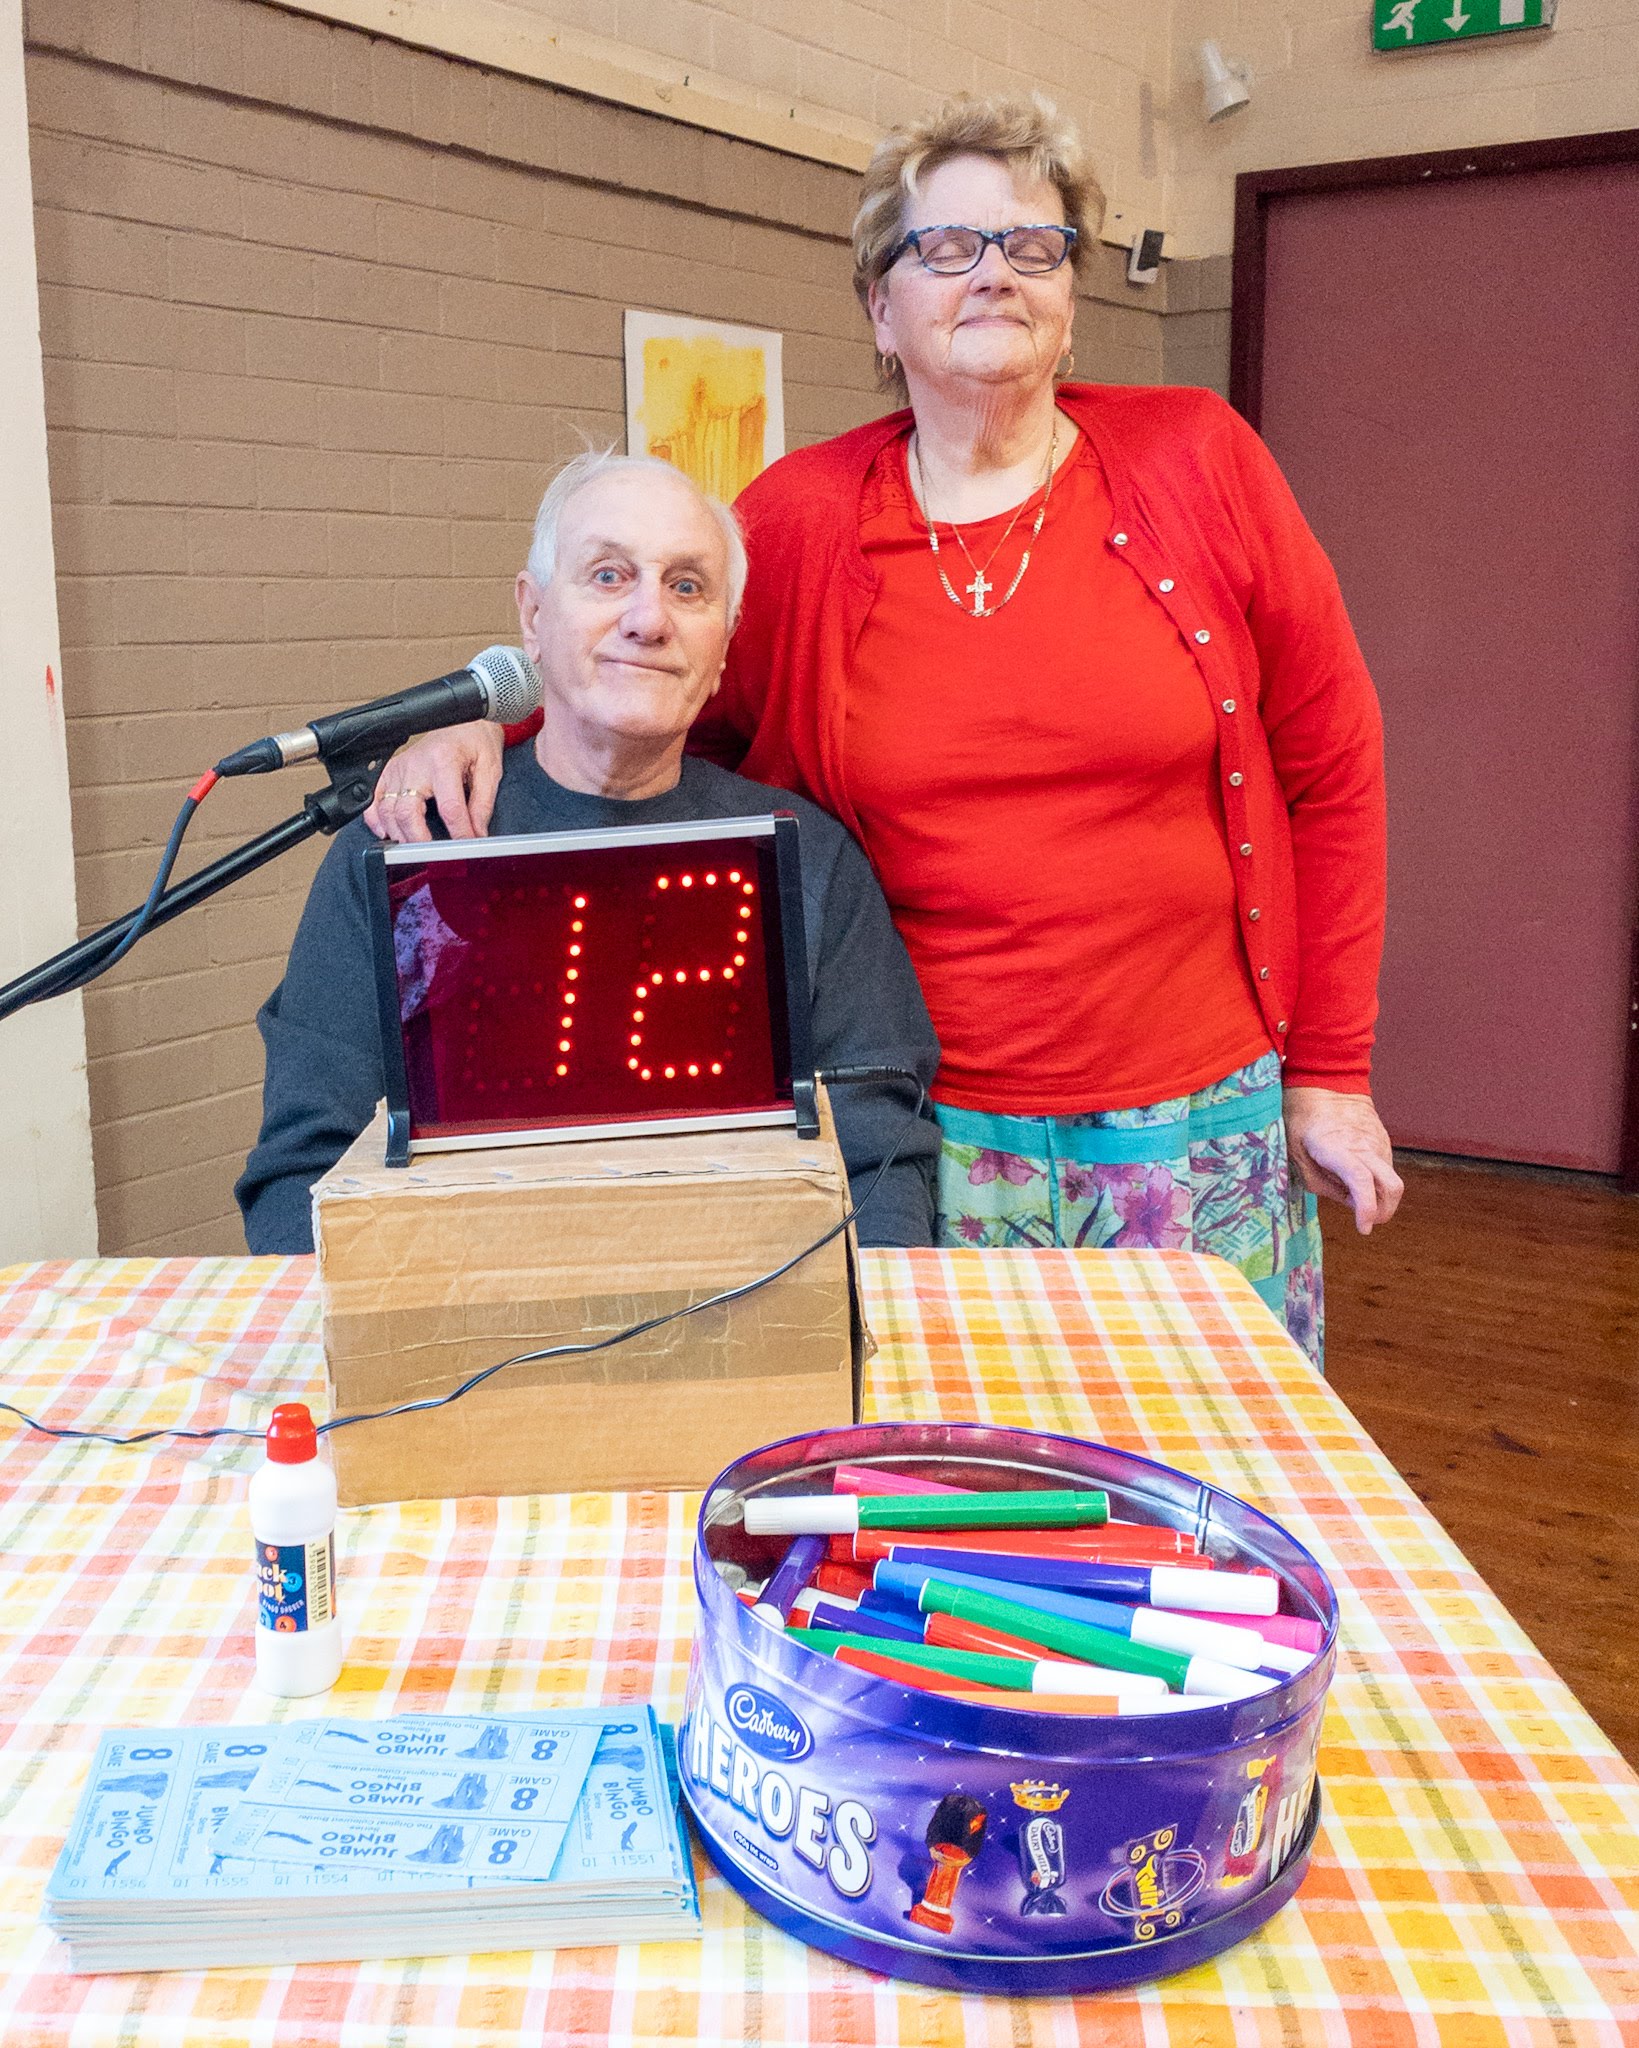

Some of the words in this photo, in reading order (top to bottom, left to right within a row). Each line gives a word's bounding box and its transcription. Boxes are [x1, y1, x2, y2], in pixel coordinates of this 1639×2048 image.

[556, 870, 754, 1081] 12
[729, 1690, 801, 1750] Cadbury
[377, 1732, 446, 1744] BINGO
[530, 1728, 571, 1738] GAME
[107, 1744, 126, 1767] GAME
[129, 1748, 173, 1760] 8
[203, 1742, 220, 1764] GAME
[224, 1744, 268, 1757] 8
[375, 1745, 449, 1756] JUMBO
[531, 1739, 558, 1761] 8
[350, 1780, 422, 1793] BINGO
[509, 1776, 552, 1786] GAME
[349, 1794, 424, 1806] JUMBO
[510, 1787, 539, 1811] 8
[603, 1782, 628, 1820] BINGO
[626, 1777, 653, 1815] JUMBO
[692, 1691, 875, 1894] HEROES
[133, 1804, 157, 1845] JUMBO
[211, 1806, 229, 1834] BIN
[106, 1810, 131, 1849] BINGO
[321, 1832, 396, 1844] BINGO
[488, 1827, 532, 1838] GAME
[319, 1846, 398, 1858] JUMBO
[488, 1839, 518, 1865] 8
[612, 1854, 655, 1866] 11551
[305, 1873, 349, 1884] 11554
